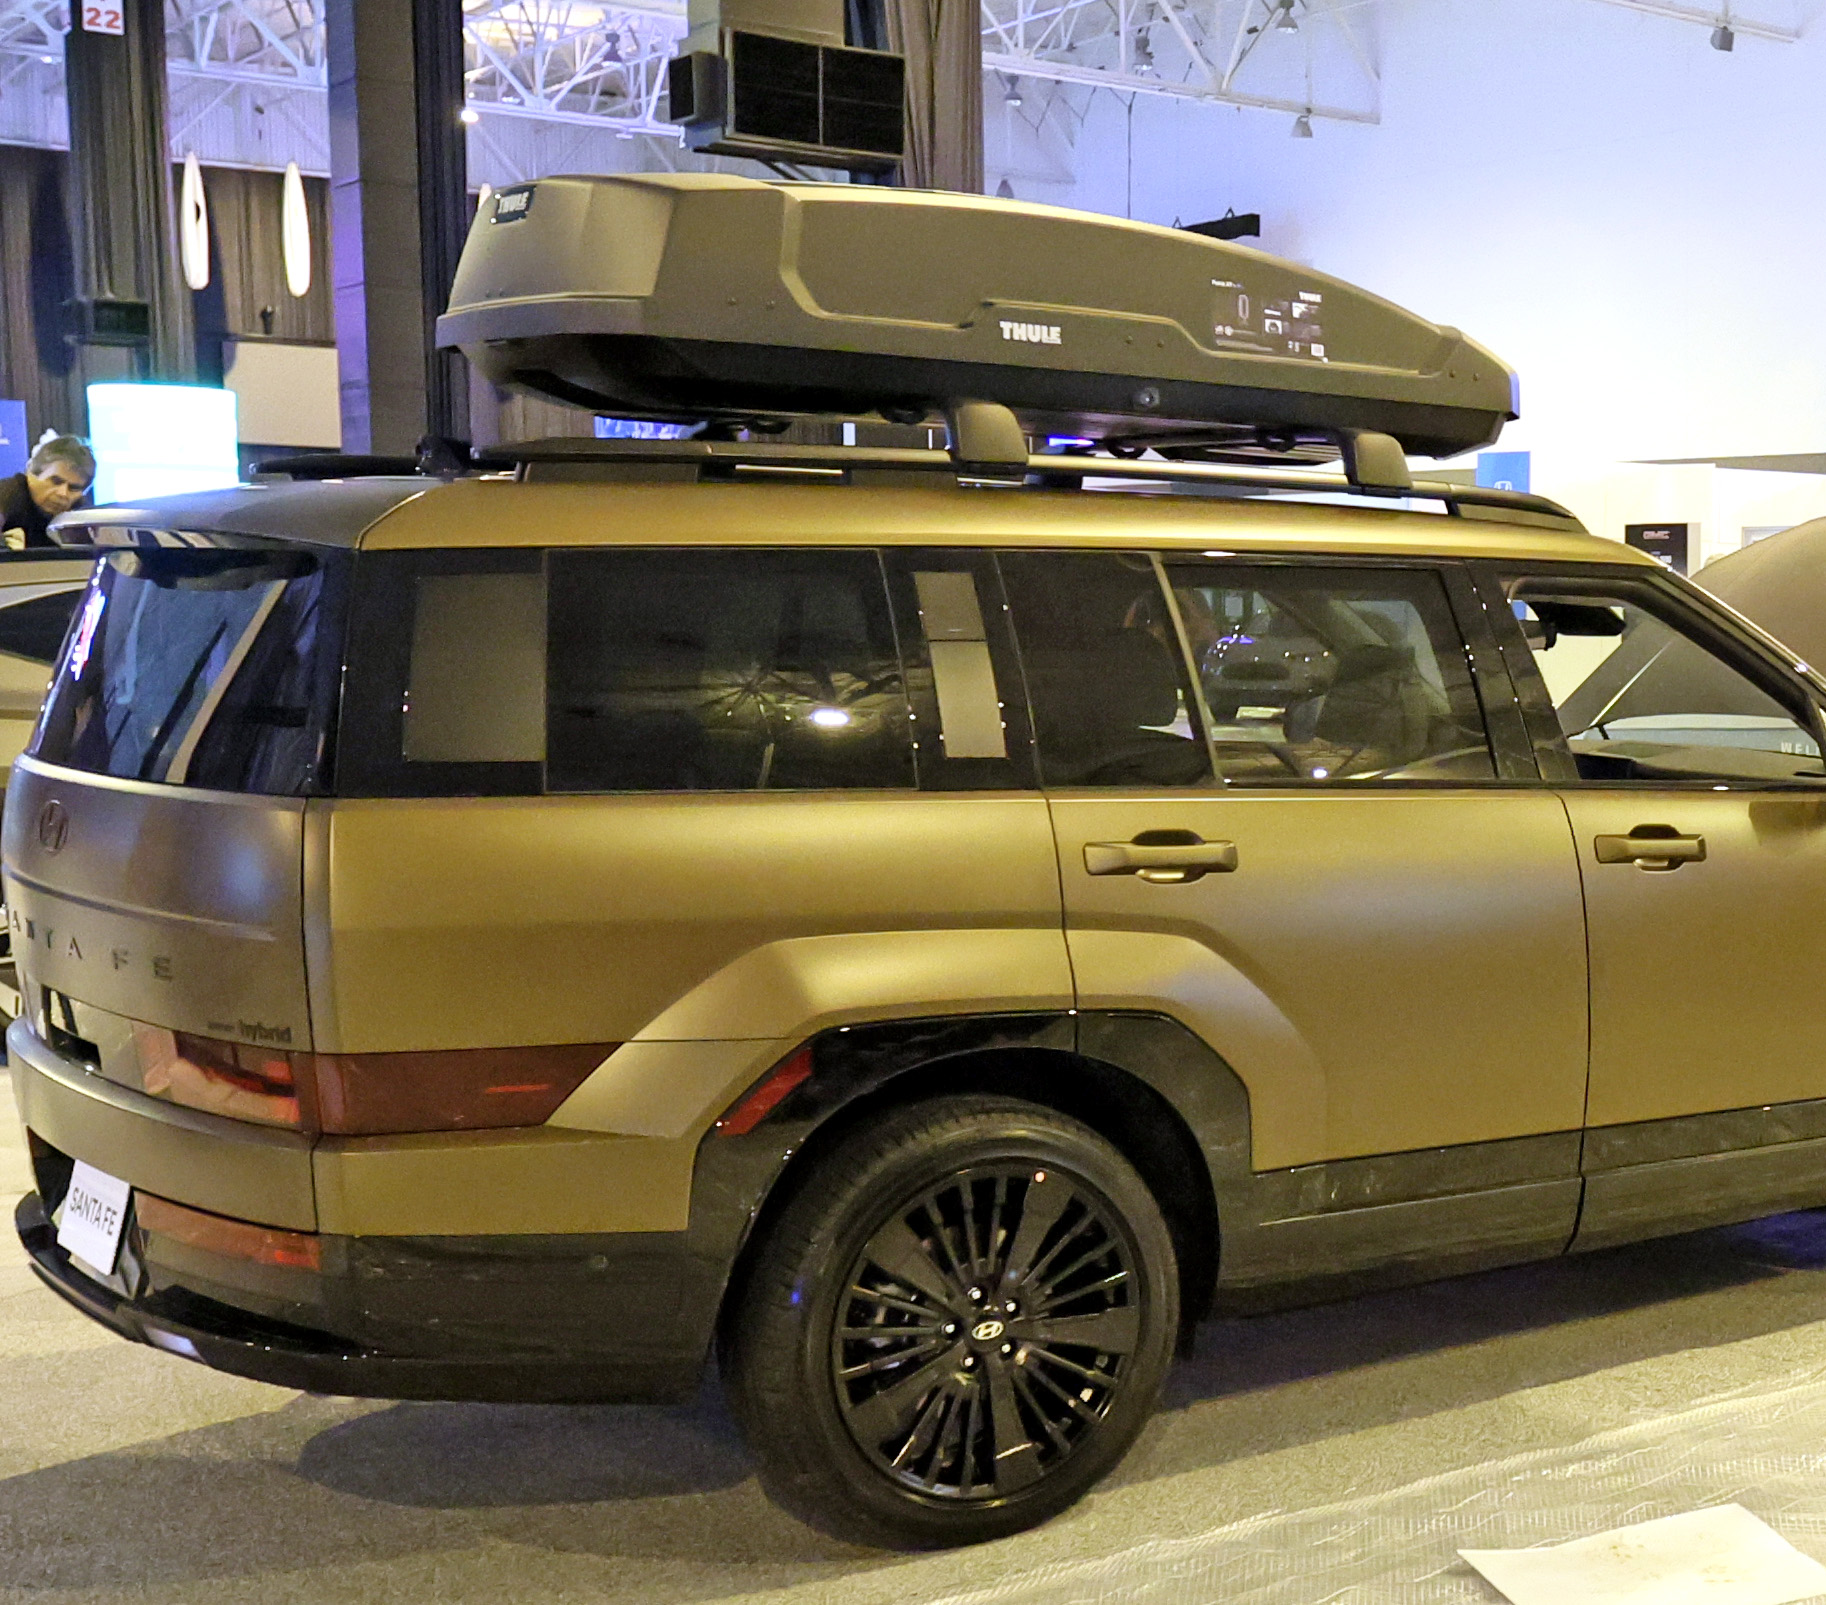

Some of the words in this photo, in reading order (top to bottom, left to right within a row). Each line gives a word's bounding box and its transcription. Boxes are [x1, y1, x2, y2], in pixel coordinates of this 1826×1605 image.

[86, 7, 121, 29] 22
[999, 320, 1062, 345] THULE
[112, 946, 174, 983] FE
[70, 1186, 103, 1229] SANTA
[101, 1205, 119, 1237] FE
